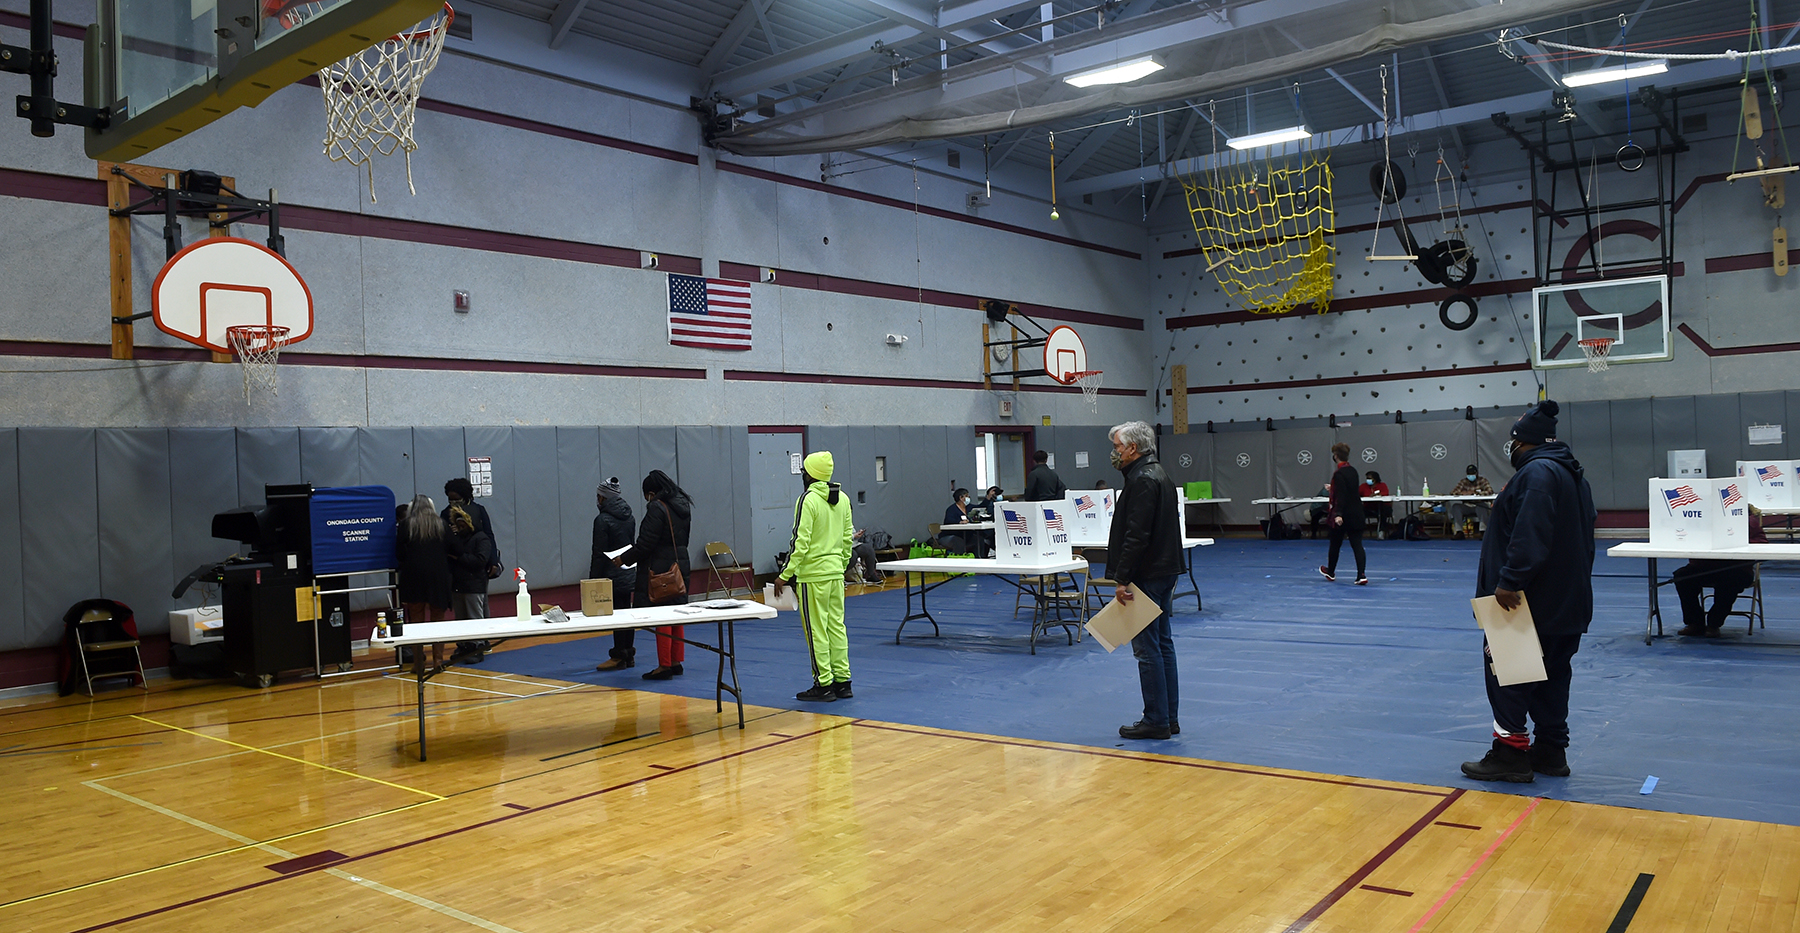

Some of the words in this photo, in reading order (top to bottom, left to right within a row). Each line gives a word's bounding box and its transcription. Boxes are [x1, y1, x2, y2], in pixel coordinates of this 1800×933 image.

[1003, 401, 1011, 412] EXIT
[1682, 510, 1702, 518] VOTE
[1731, 508, 1743, 516] VOTE
[1013, 536, 1033, 546] VOTE
[1052, 533, 1068, 544] VOTE
